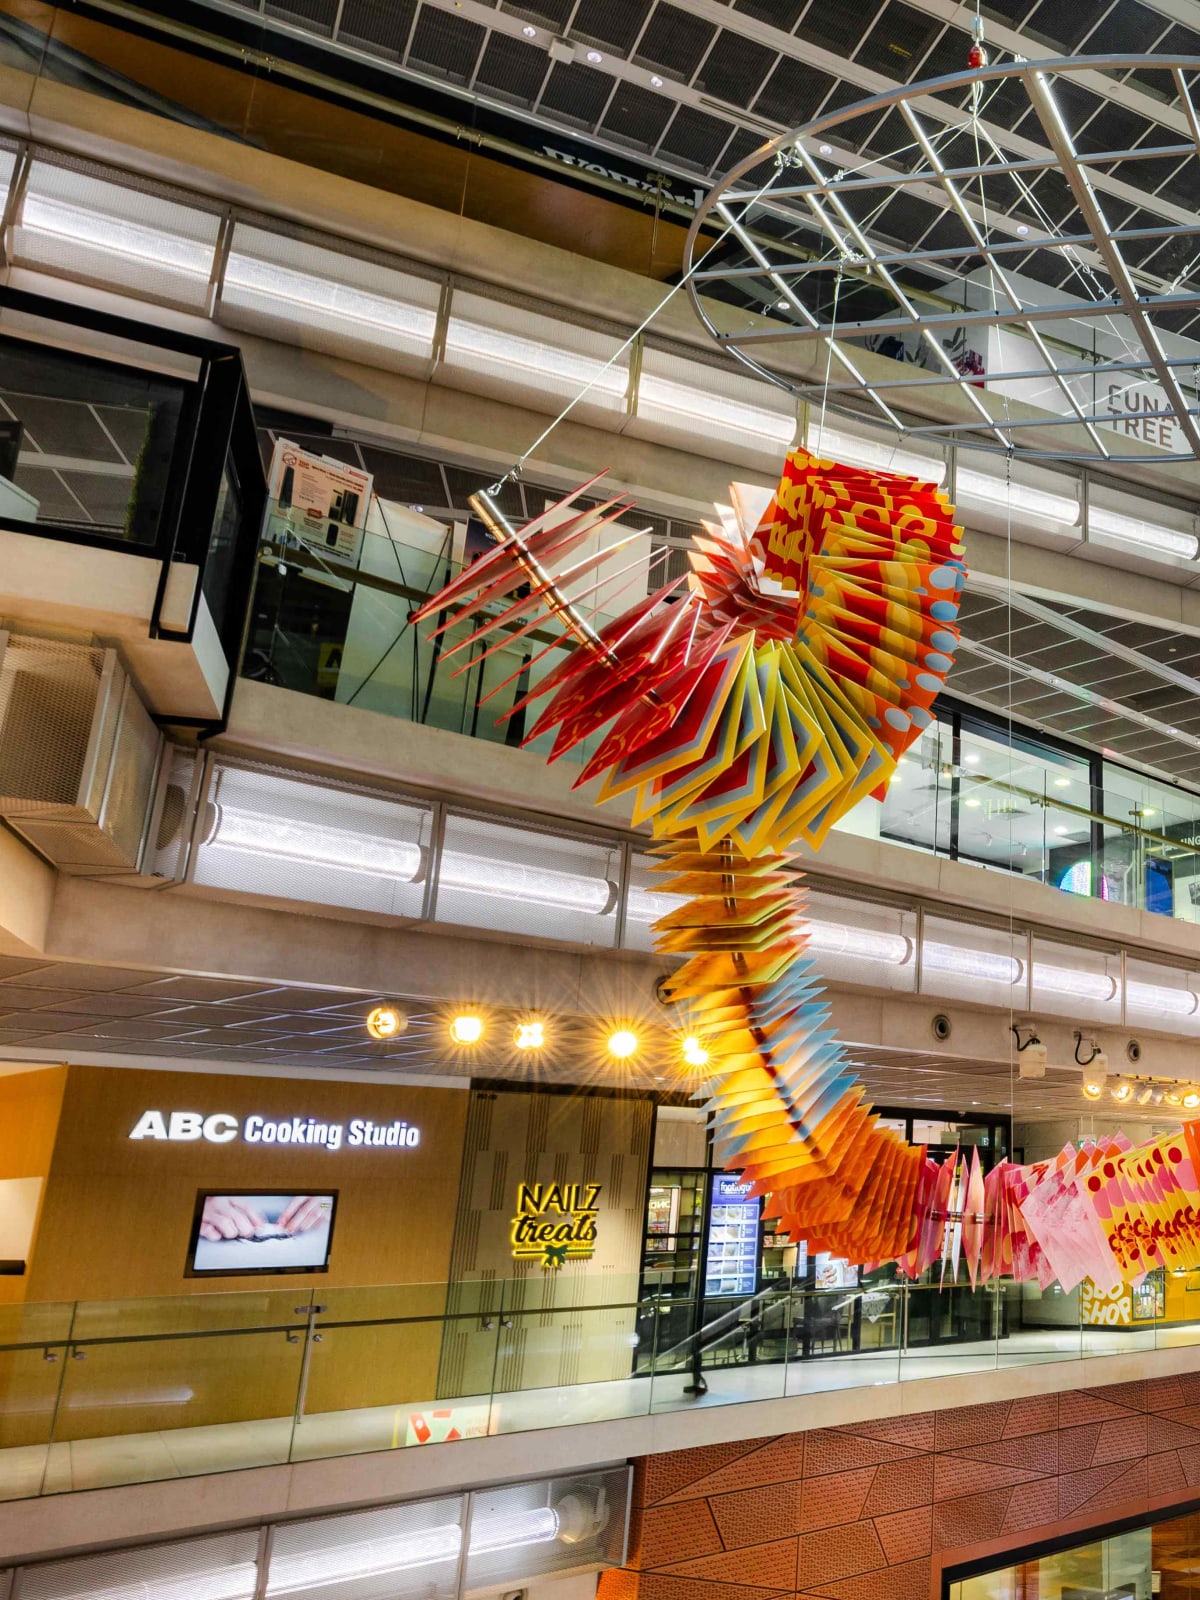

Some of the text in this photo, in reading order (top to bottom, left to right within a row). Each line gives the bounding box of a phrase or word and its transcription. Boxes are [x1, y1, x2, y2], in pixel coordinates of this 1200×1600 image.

[1107, 406, 1173, 448] TREE
[128, 1110, 420, 1150] ABC Cooking Studio
[518, 1184, 602, 1213] NAILZ
[514, 1213, 598, 1244] treats
[1082, 1296, 1131, 1325] SHOP
